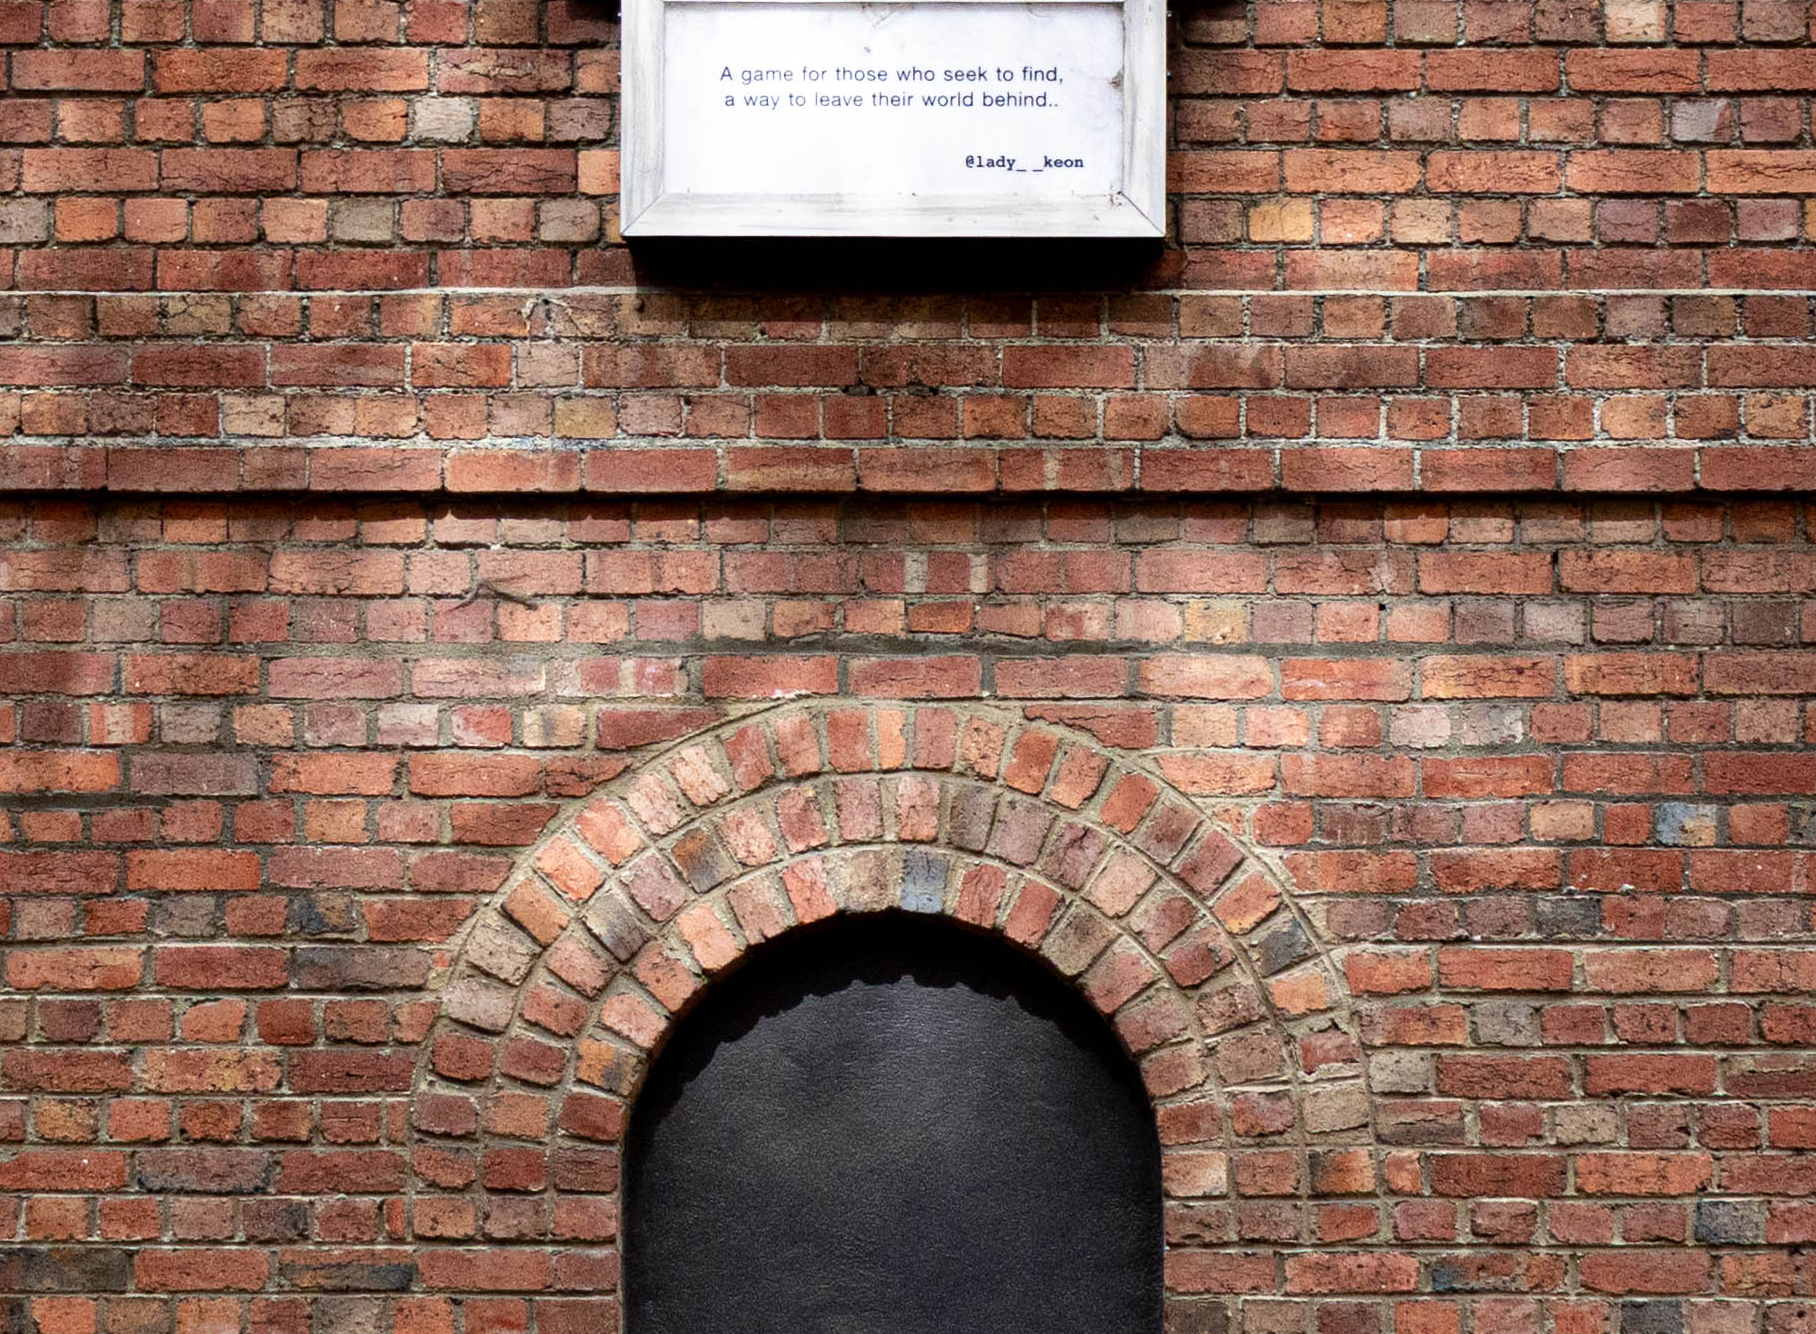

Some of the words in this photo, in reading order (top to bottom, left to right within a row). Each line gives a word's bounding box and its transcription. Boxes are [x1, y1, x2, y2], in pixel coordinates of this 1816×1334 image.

[719, 66, 734, 82] A
[741, 69, 794, 86] game
[802, 66, 828, 82] for
[835, 66, 888, 82] those
[896, 66, 936, 82] who
[943, 66, 988, 82] seek
[995, 66, 1015, 83] to
[1021, 65, 1064, 85] find,
[724, 94, 736, 107] a
[743, 94, 780, 111] way
[788, 92, 806, 107] to
[815, 91, 864, 107] leave
[871, 91, 914, 107] their
[921, 91, 974, 108] world
[982, 91, 1059, 108] behind..
